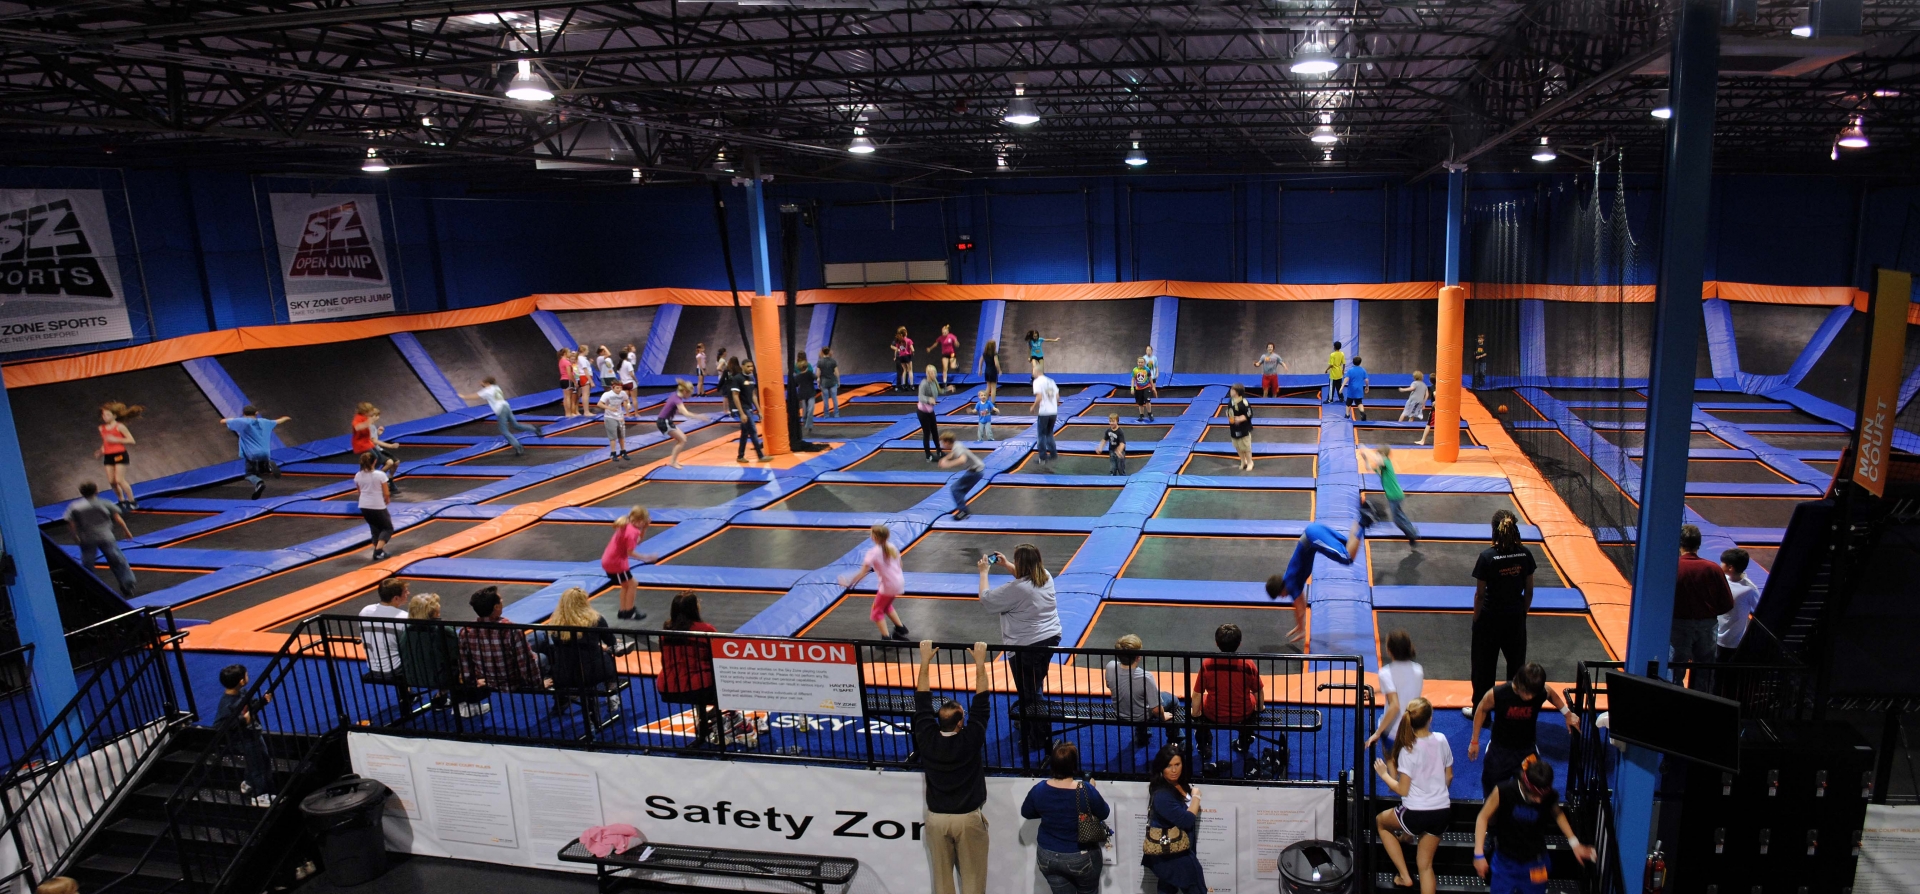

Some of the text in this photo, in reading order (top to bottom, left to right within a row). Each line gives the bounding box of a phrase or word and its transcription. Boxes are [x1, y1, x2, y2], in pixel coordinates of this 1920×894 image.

[305, 208, 362, 244] SZ
[296, 255, 371, 269] OPEN JUMP
[290, 294, 391, 310] SKY ZONE OPEN JUMP
[2, 316, 107, 335] ZONE SPORTS
[12, 335, 41, 343] NEVER
[43, 331, 79, 340] BEFORE!
[1859, 417, 1874, 478] MAIN
[1868, 396, 1887, 483] COURT
[722, 641, 846, 662] CAUTION
[771, 715, 857, 731] SKY
[645, 795, 814, 840] Safety
